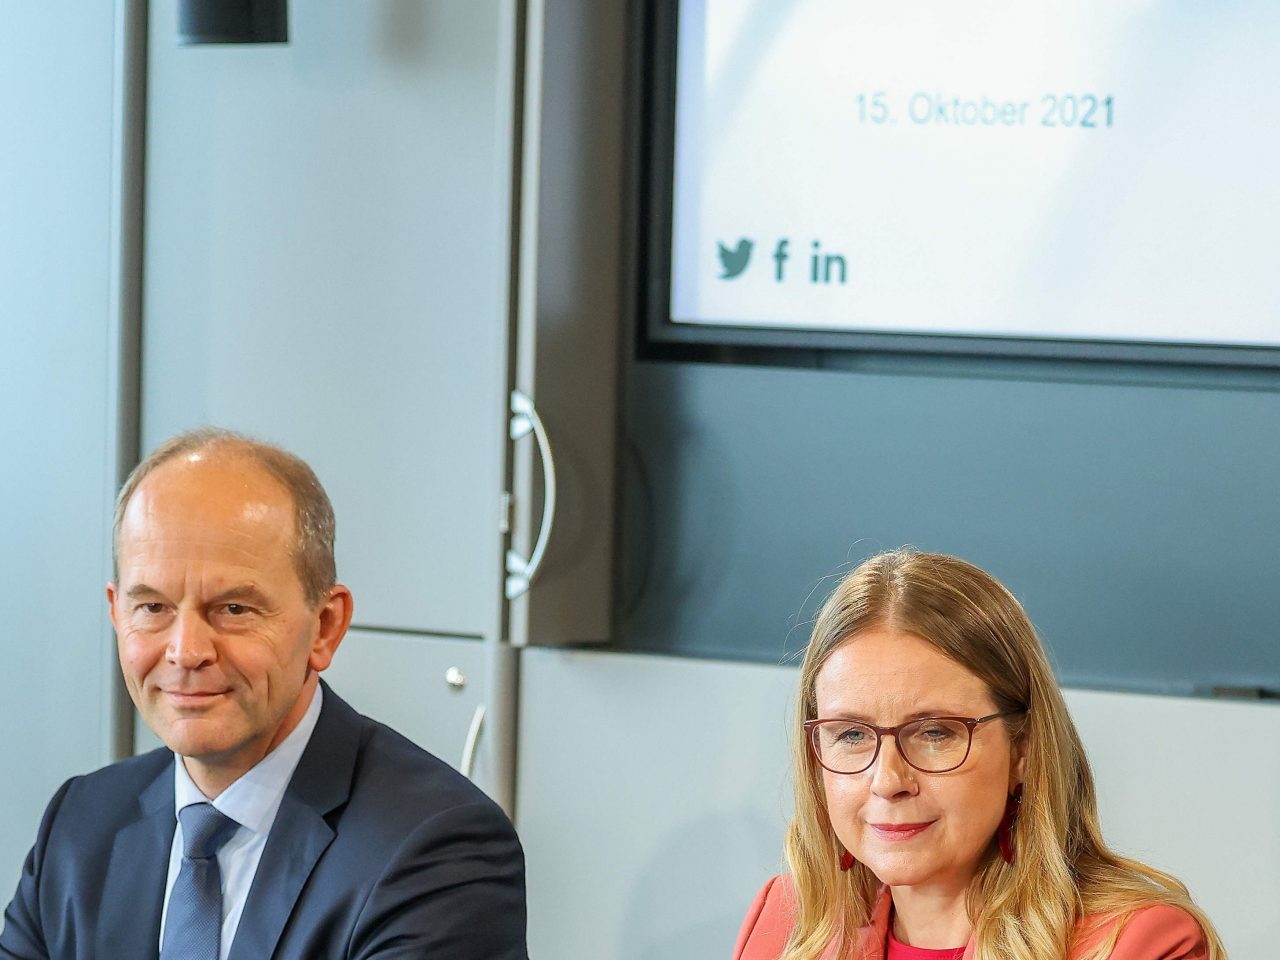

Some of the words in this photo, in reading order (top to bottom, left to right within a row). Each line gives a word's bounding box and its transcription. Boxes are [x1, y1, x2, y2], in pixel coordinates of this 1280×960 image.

[856, 91, 897, 125] 15.
[908, 91, 1030, 126] Oktober
[1040, 93, 1114, 128] 2021
[811, 239, 848, 284] in
